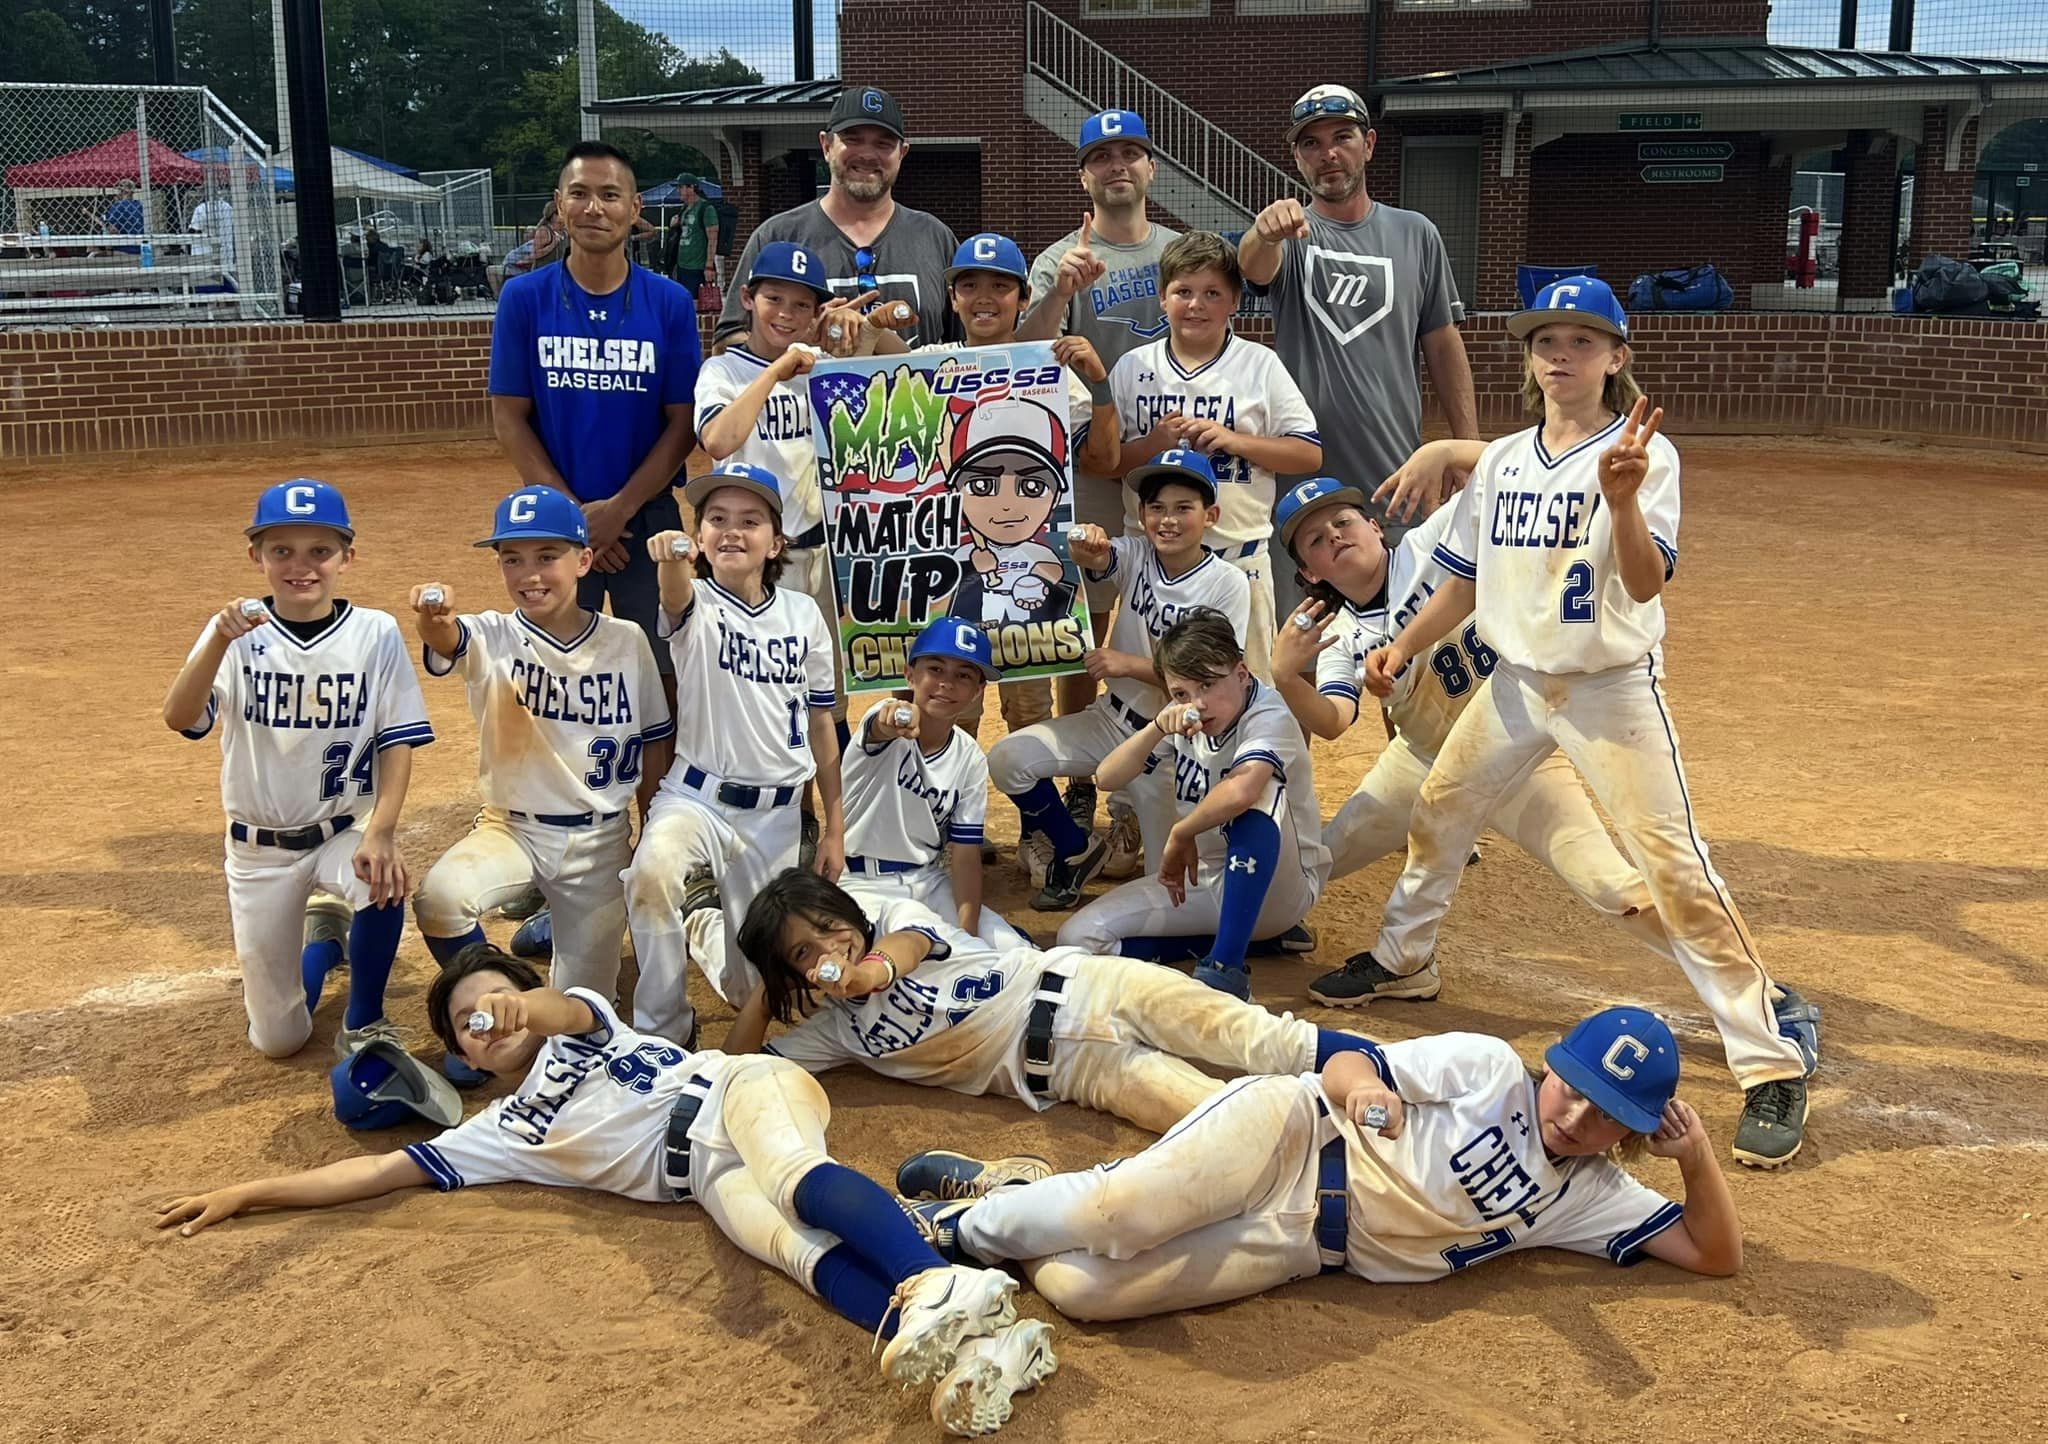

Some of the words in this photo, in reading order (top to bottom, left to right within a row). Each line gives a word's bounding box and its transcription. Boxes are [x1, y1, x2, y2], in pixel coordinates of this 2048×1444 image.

[863, 90, 883, 113] C
[1100, 112, 1122, 136] C
[1631, 117, 1672, 127] FIELD
[1641, 145, 1726, 157] CONCESSIONS
[1651, 167, 1718, 178] RESTROOMS
[791, 250, 807, 275] C
[973, 238, 997, 261] C
[1109, 261, 1160, 283] CHELSE
[1090, 278, 1157, 316] BASEB
[1549, 285, 1581, 310] C
[537, 335, 656, 374] CHELSEA
[939, 364, 978, 374] ALABAMA
[546, 371, 648, 392] BASEBALL
[1021, 388, 1059, 397] BASEBALL
[830, 357, 960, 487] MAY
[1159, 449, 1185, 466] C
[286, 486, 316, 515] C
[1295, 482, 1324, 505] C
[509, 494, 537, 523] C
[835, 493, 963, 557] MATCH
[848, 554, 963, 626] UP
[1560, 560, 1596, 624] 2
[849, 618, 1086, 681] CHIONS
[955, 624, 977, 653] C
[1429, 620, 1499, 699] 88
[242, 665, 368, 729] CHELSEA
[511, 658, 632, 726] CHELSEA
[319, 737, 377, 802] 24
[584, 735, 643, 791] 30
[1601, 1033, 1649, 1081] C
[1448, 1125, 1545, 1229] CHEL
